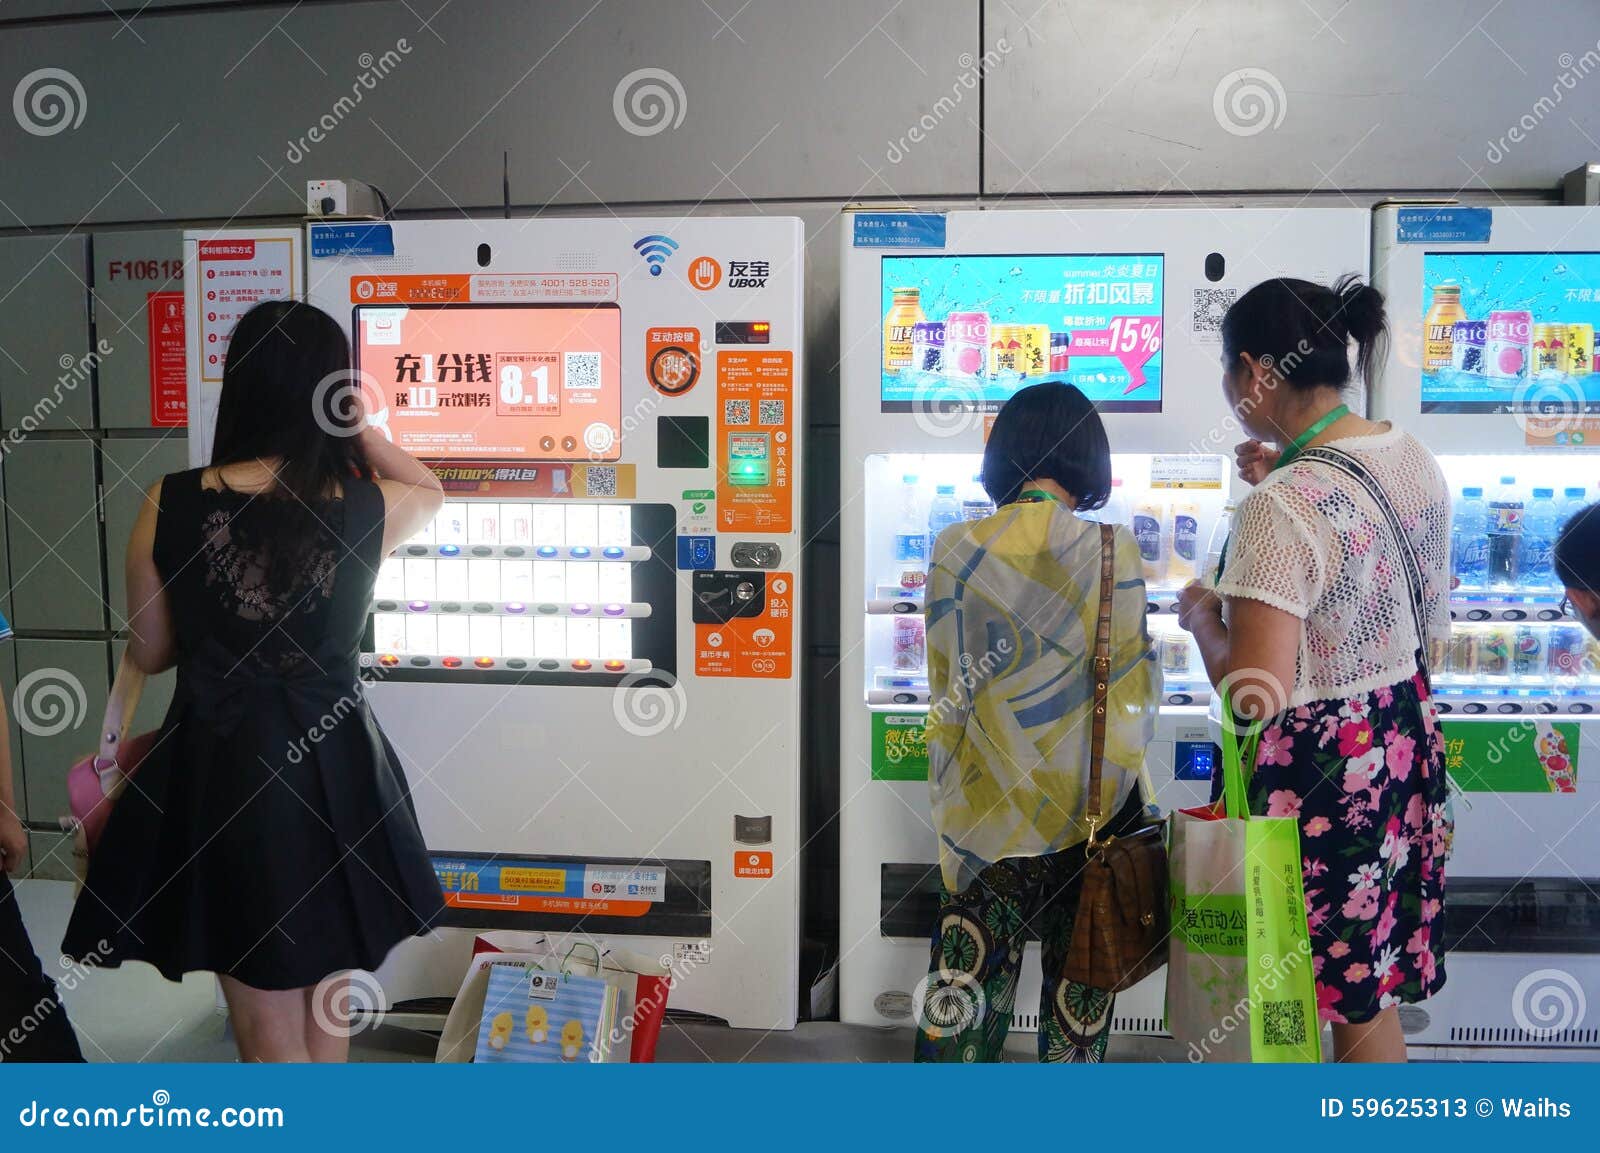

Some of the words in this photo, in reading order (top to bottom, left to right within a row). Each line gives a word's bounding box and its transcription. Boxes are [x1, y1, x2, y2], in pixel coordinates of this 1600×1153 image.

[729, 261, 769, 277] 友宝
[1103, 264, 1158, 278] 炎炎夏日
[728, 278, 767, 288] UBOX
[1064, 282, 1154, 305] 折扣风暴
[951, 322, 989, 337] RIO
[1109, 318, 1160, 353] 15%
[1492, 322, 1531, 337] RIO
[394, 353, 492, 383] 充1分钱
[500, 364, 558, 405] 8.1%
[163, 401, 187, 410] 火警电
[395, 386, 491, 409] 送10元饮料券
[1444, 738, 1464, 755] 付
[1446, 755, 1464, 768] 奖
